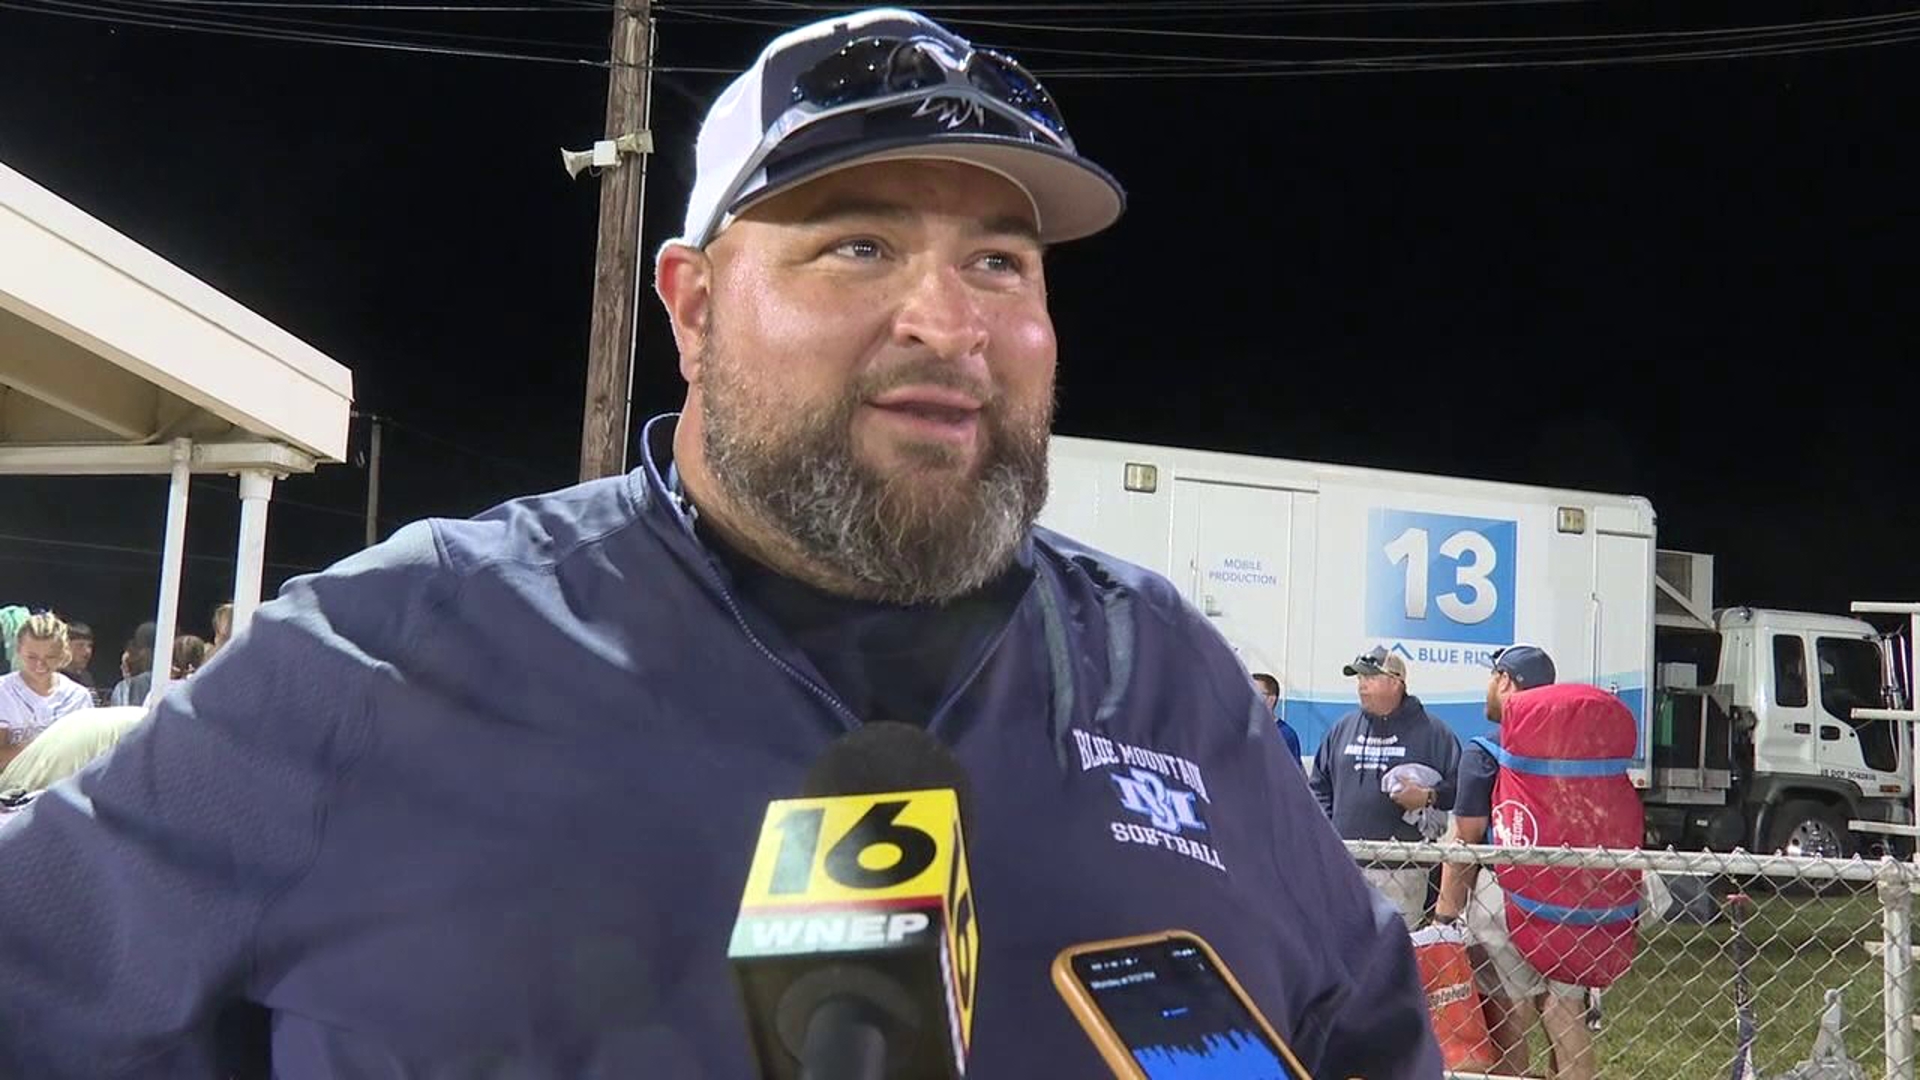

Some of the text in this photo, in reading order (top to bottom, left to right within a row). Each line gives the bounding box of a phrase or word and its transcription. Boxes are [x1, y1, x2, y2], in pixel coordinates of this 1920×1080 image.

[1208, 569, 1277, 585] PRODUCTION
[1223, 558, 1262, 571] MOBILE
[1383, 527, 1498, 626] 13
[1418, 647, 1494, 666] BLUE RID
[1072, 728, 1211, 805] BLUE MOUNTAIN
[767, 800, 938, 895] 16
[1110, 822, 1227, 872] SOFTBALL
[749, 912, 930, 949] WNEP
